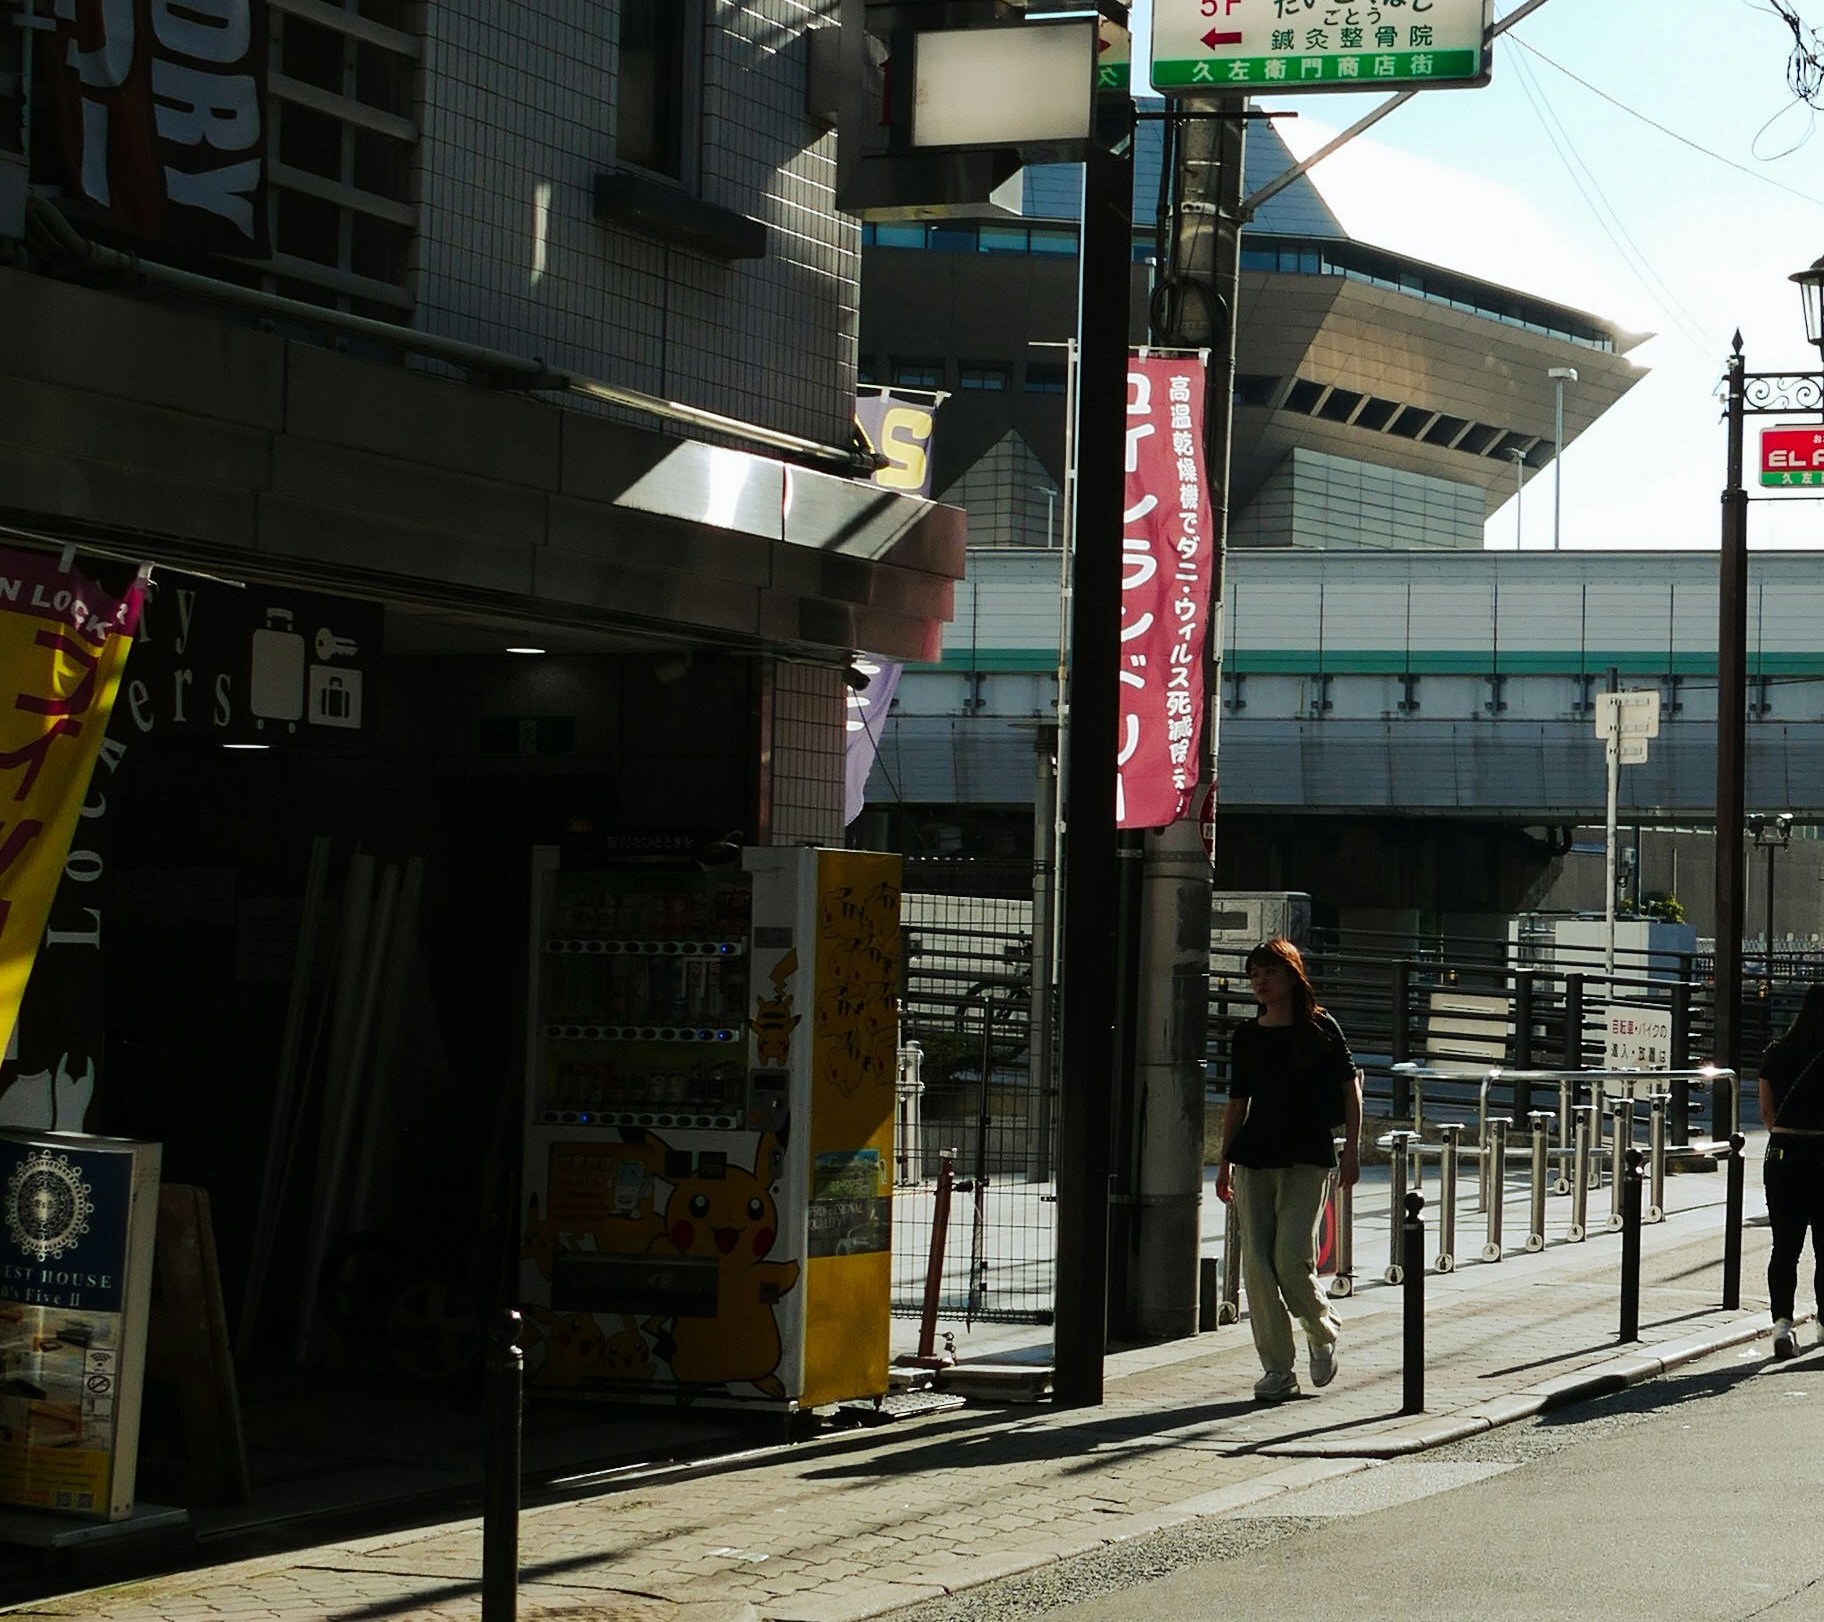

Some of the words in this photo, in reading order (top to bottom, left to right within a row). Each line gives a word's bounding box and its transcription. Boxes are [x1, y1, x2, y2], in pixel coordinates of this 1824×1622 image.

[1323, 7, 1382, 27] ごとう
[1271, 24, 1433, 51] 鍼灸整骨院
[1192, 54, 1433, 83] 久左衛門商店街
[1768, 450, 1807, 467] EL
[41, 1269, 113, 1290] HOUSE
